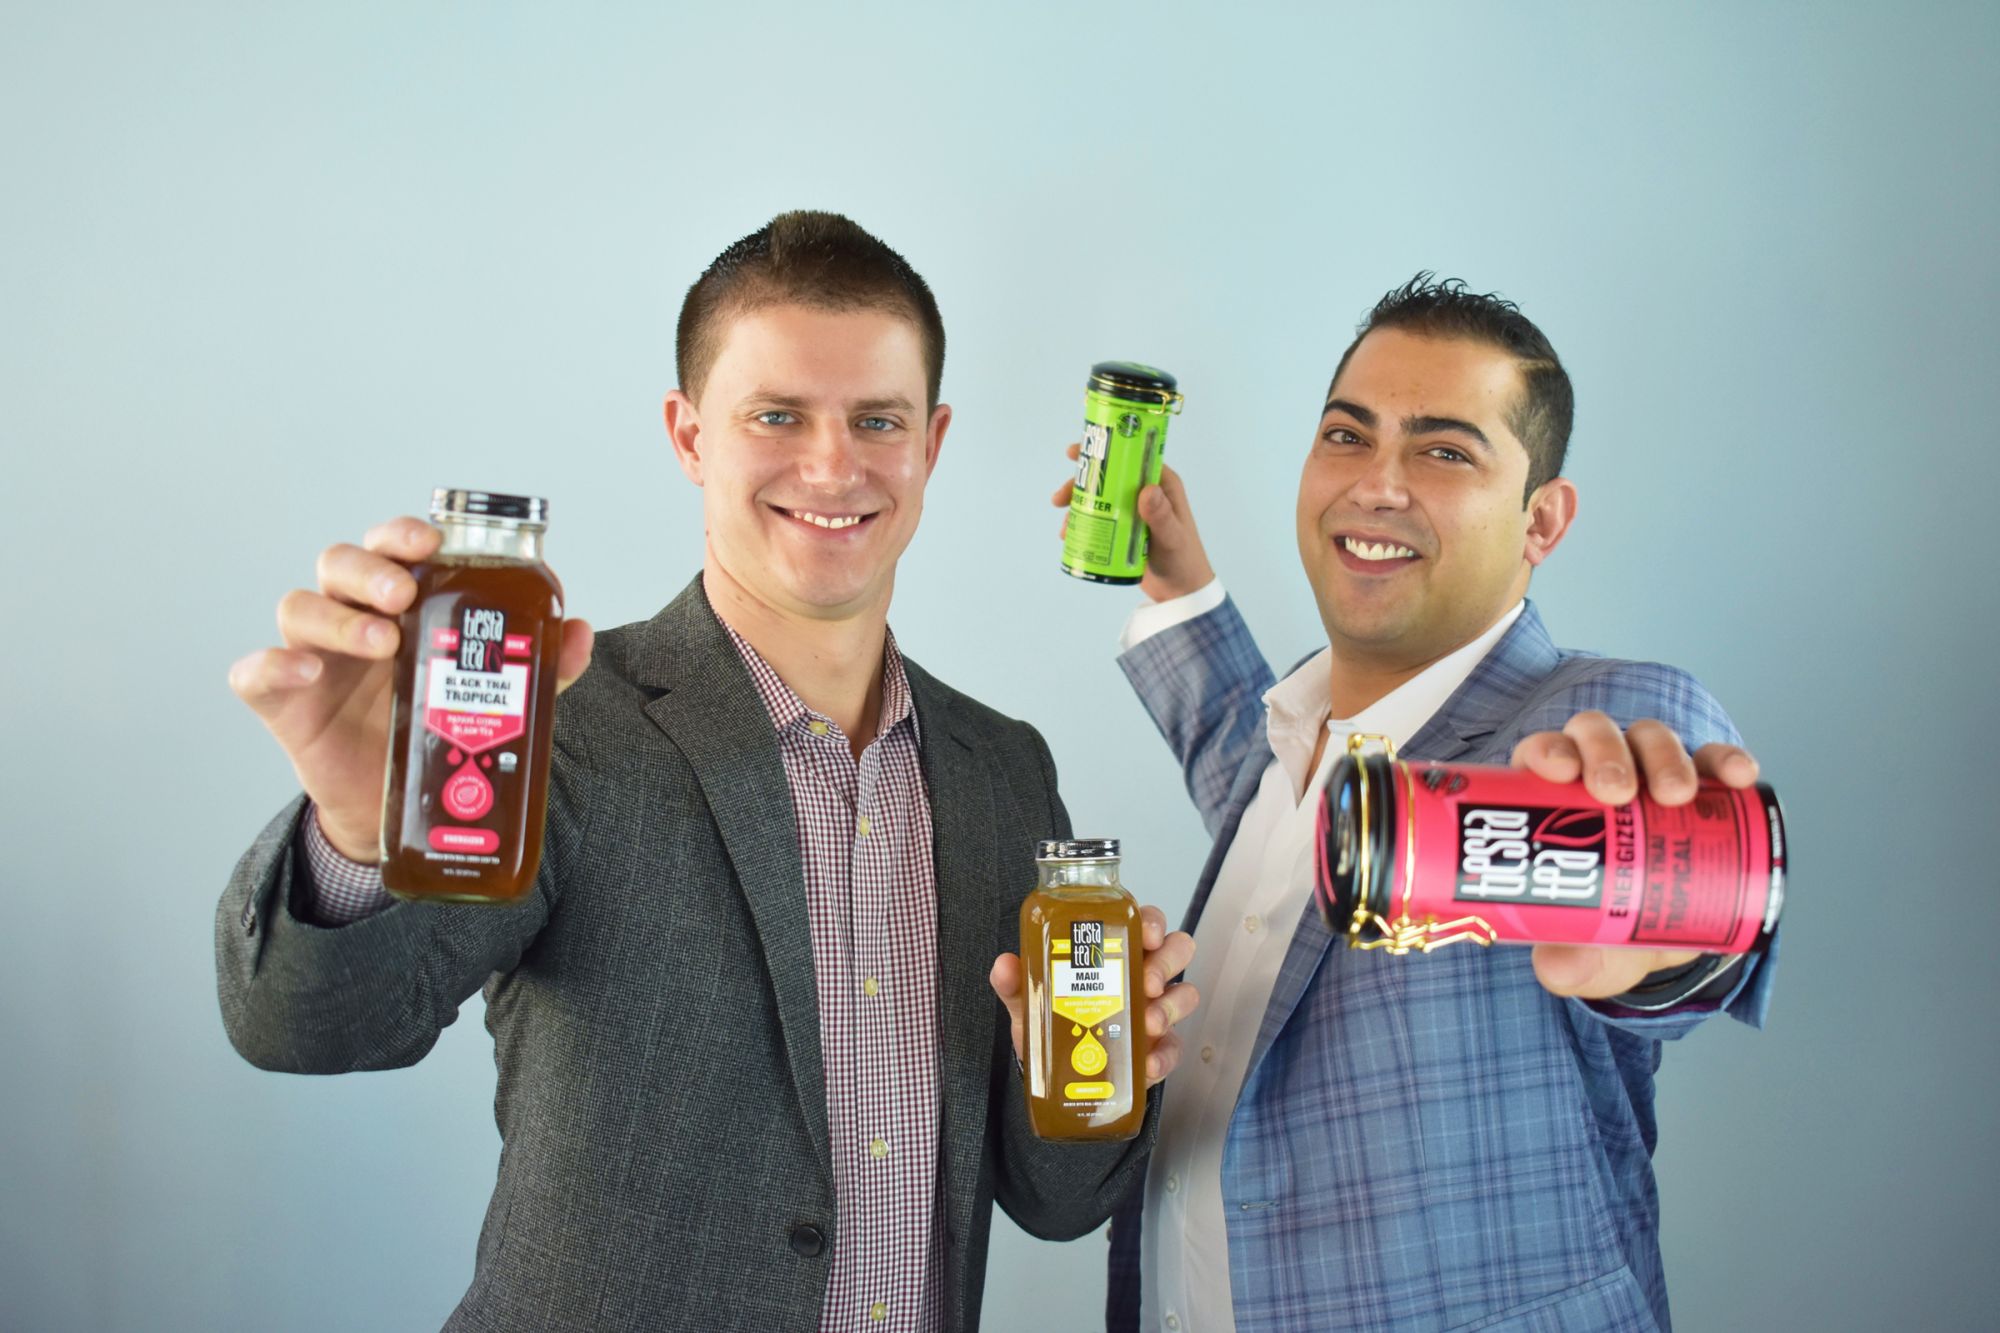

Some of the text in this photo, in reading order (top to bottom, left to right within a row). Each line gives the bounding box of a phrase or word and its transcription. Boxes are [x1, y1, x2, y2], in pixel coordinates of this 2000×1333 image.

[463, 608, 504, 642] tiesta
[461, 639, 485, 671] tea
[446, 676, 511, 690] BLACK THAI
[446, 689, 508, 705] TROPICAL
[1460, 809, 1600, 899] tiesta tea
[1609, 803, 1635, 918] ENERGIZER
[1664, 837, 1691, 930] TROPICAL
[1073, 922, 1101, 944] tiesta
[1073, 945, 1090, 966] tea
[1071, 983, 1104, 992] MANGO
[1075, 972, 1099, 981] MAUI
